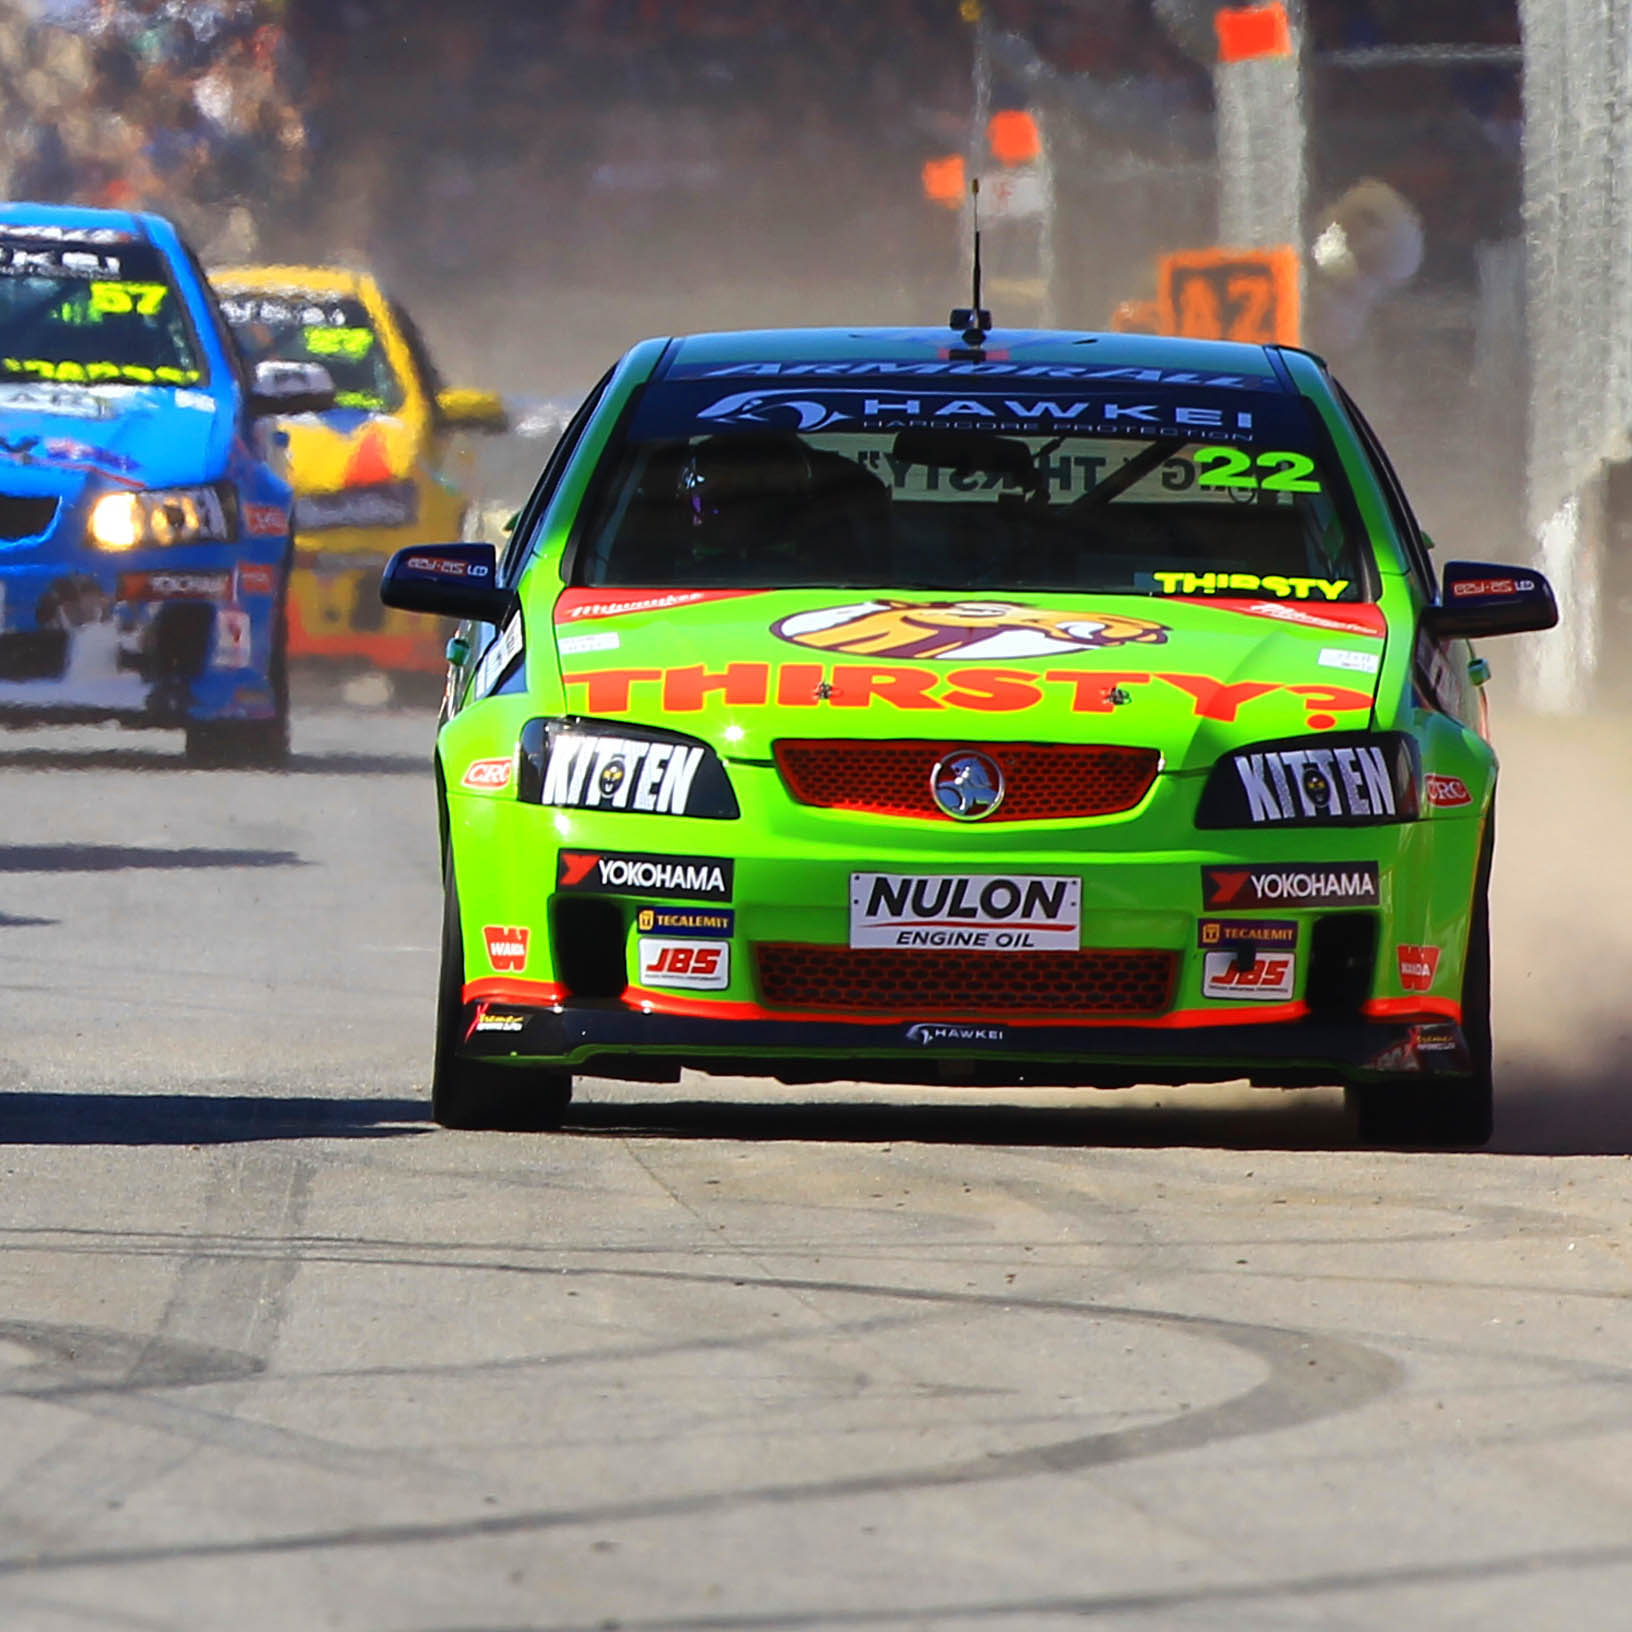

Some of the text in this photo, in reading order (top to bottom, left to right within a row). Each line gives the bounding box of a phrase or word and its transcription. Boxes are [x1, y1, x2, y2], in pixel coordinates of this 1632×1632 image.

[90, 281, 167, 316] 57
[864, 399, 1253, 430] HAWKEI
[1054, 423, 1254, 443] PROTECTION
[1194, 446, 1321, 493] 22
[1153, 571, 1351, 601] THIRSTY
[565, 662, 1374, 731] THIRSTY?
[542, 735, 703, 816] KITTEN
[1235, 746, 1396, 822] KITTEN
[598, 859, 726, 893] YOKOHAMA
[1251, 872, 1376, 900] YOKOHAMA
[866, 876, 1067, 919] NULON
[656, 915, 729, 928] TECALEMIT
[1224, 929, 1294, 941] TECALEMIT
[896, 930, 1036, 948] ENGINE OIL
[646, 948, 722, 974] JBS
[935, 1028, 1004, 1041] HAWKEI
